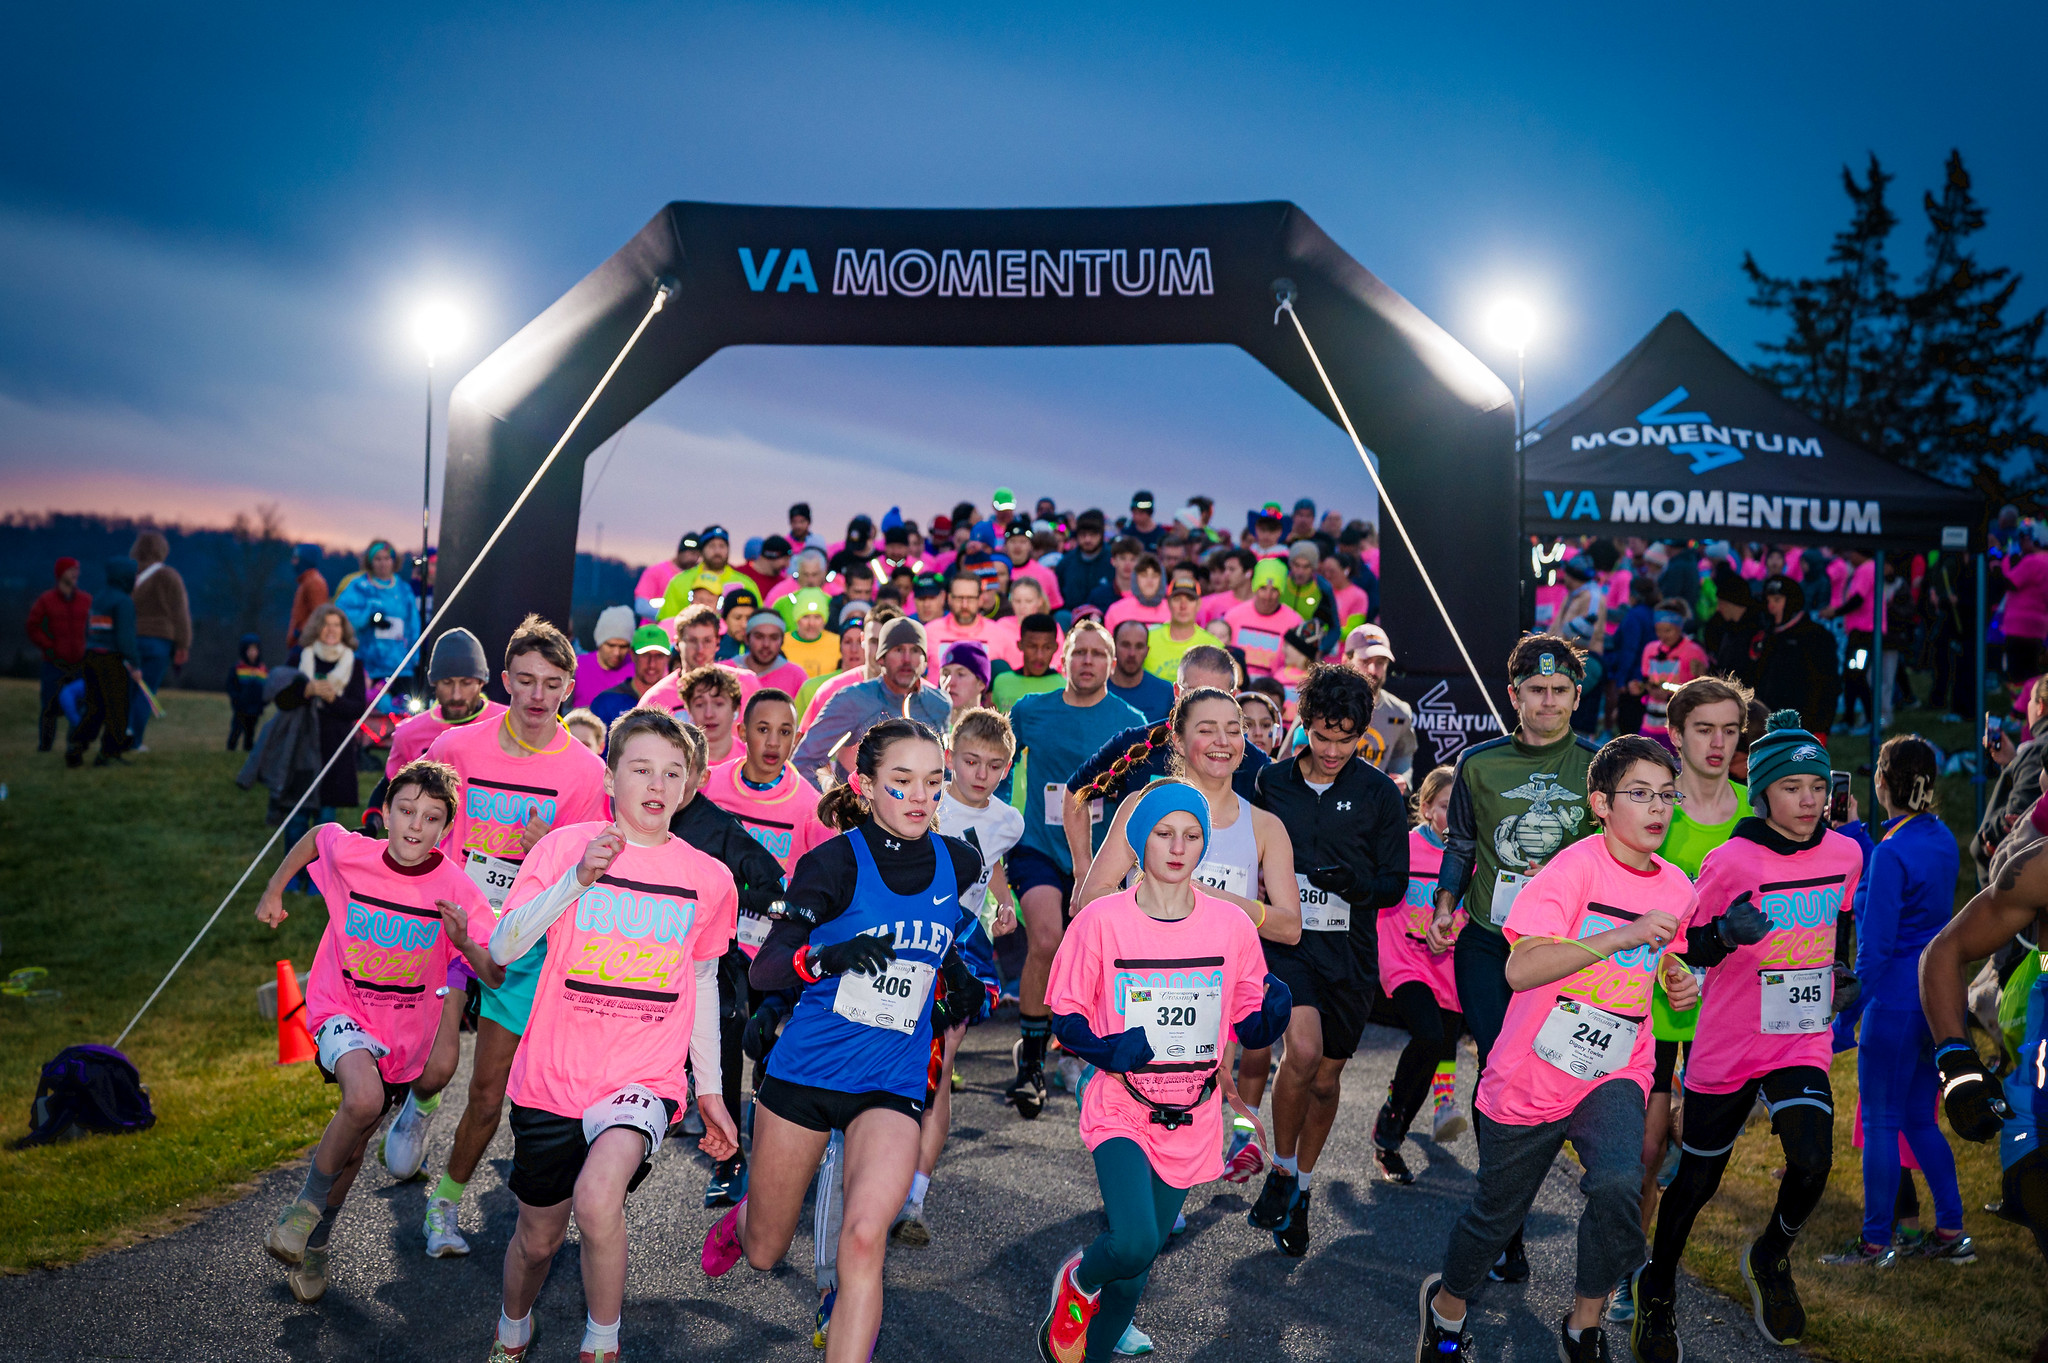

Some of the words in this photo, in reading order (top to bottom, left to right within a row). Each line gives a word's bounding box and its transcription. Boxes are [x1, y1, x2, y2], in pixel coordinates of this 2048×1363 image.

[737, 247, 819, 293] VA
[832, 248, 1214, 297] MOMENTUM
[1571, 424, 1824, 458] MOMENTUM
[1542, 490, 1600, 520] VA
[1609, 490, 1882, 535] MOMENTUM
[1410, 713, 1502, 731] MENTUM
[466, 787, 557, 827] RUN
[464, 822, 526, 855] 202
[486, 870, 516, 889] 337
[1300, 889, 1328, 905] 360
[1761, 885, 1845, 932] RUN
[344, 902, 441, 952] RUN
[575, 886, 696, 946] RUN
[343, 942, 433, 985] 2024
[872, 974, 912, 998] 406
[1789, 985, 1821, 1004] 345
[903, 1018, 918, 1028] LD
[1156, 1006, 1197, 1026] 320
[1195, 1043, 1215, 1054] LDMB
[1572, 1022, 1613, 1051] 244
[1593, 1069, 1611, 1079] LD
[611, 1093, 651, 1109] 441
